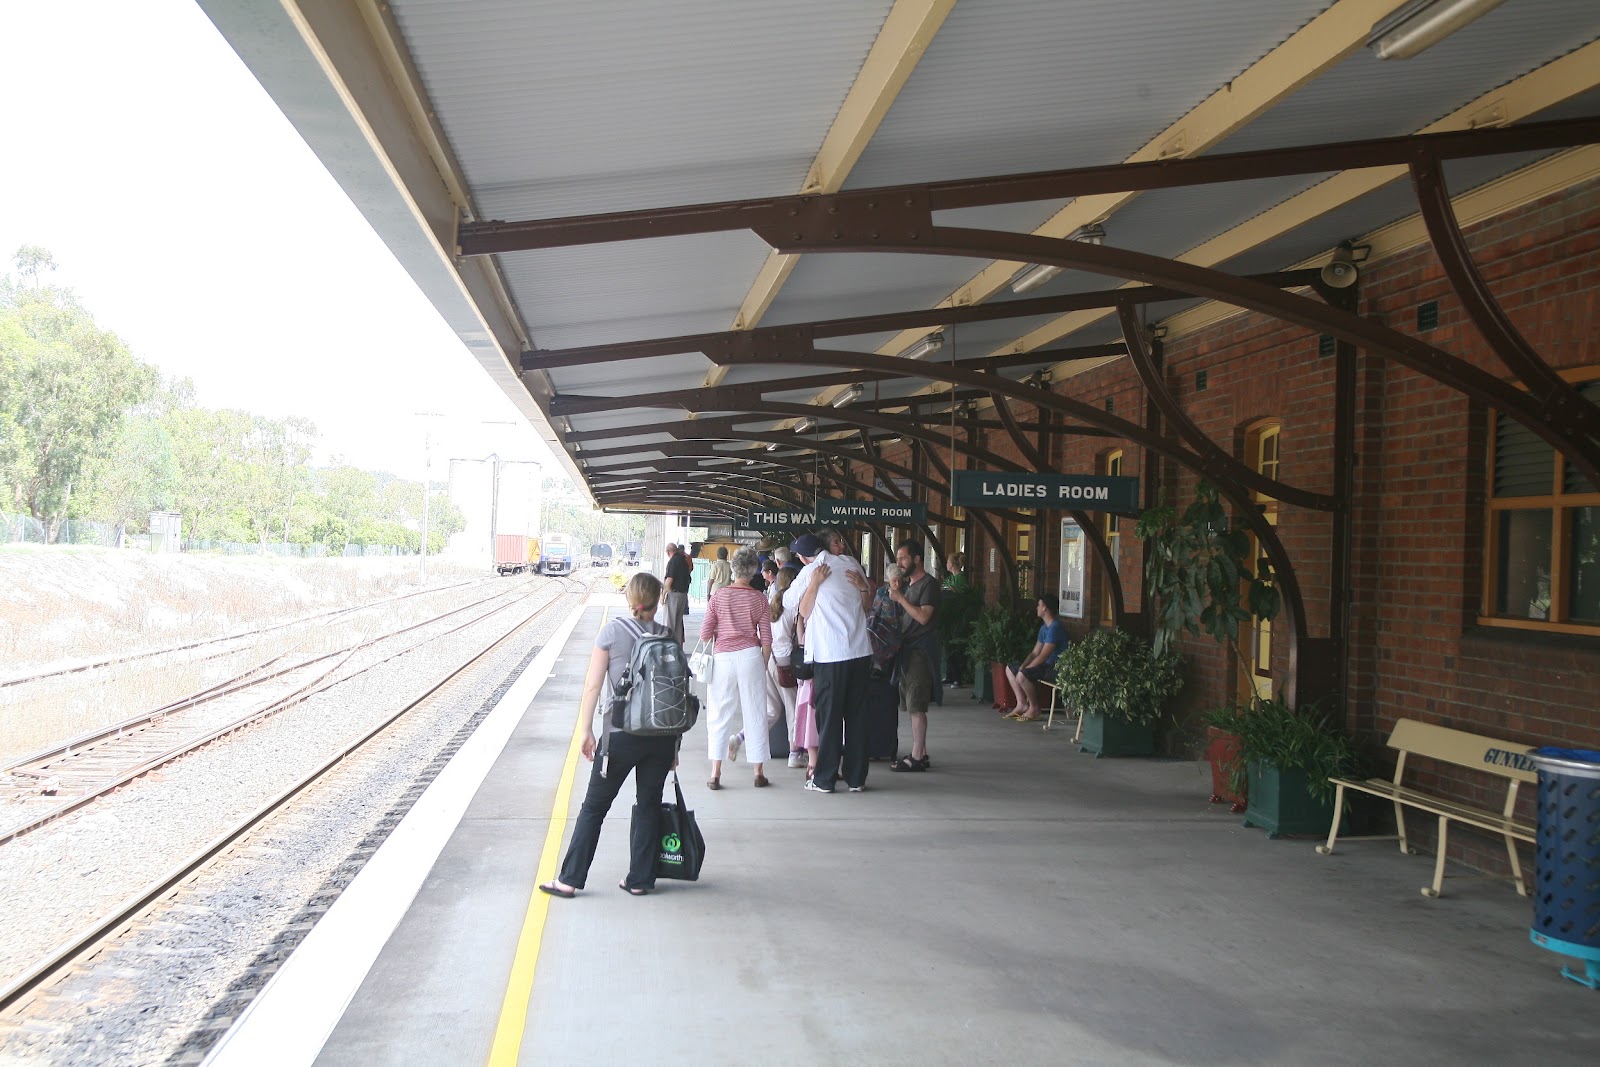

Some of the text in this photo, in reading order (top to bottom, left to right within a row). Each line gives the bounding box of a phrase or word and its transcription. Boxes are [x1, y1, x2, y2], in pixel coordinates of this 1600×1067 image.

[982, 482, 1108, 500] LADIES ROOM
[832, 506, 912, 517] WAITING ROOM
[753, 512, 788, 524] THIS
[790, 513, 816, 525] WAY
